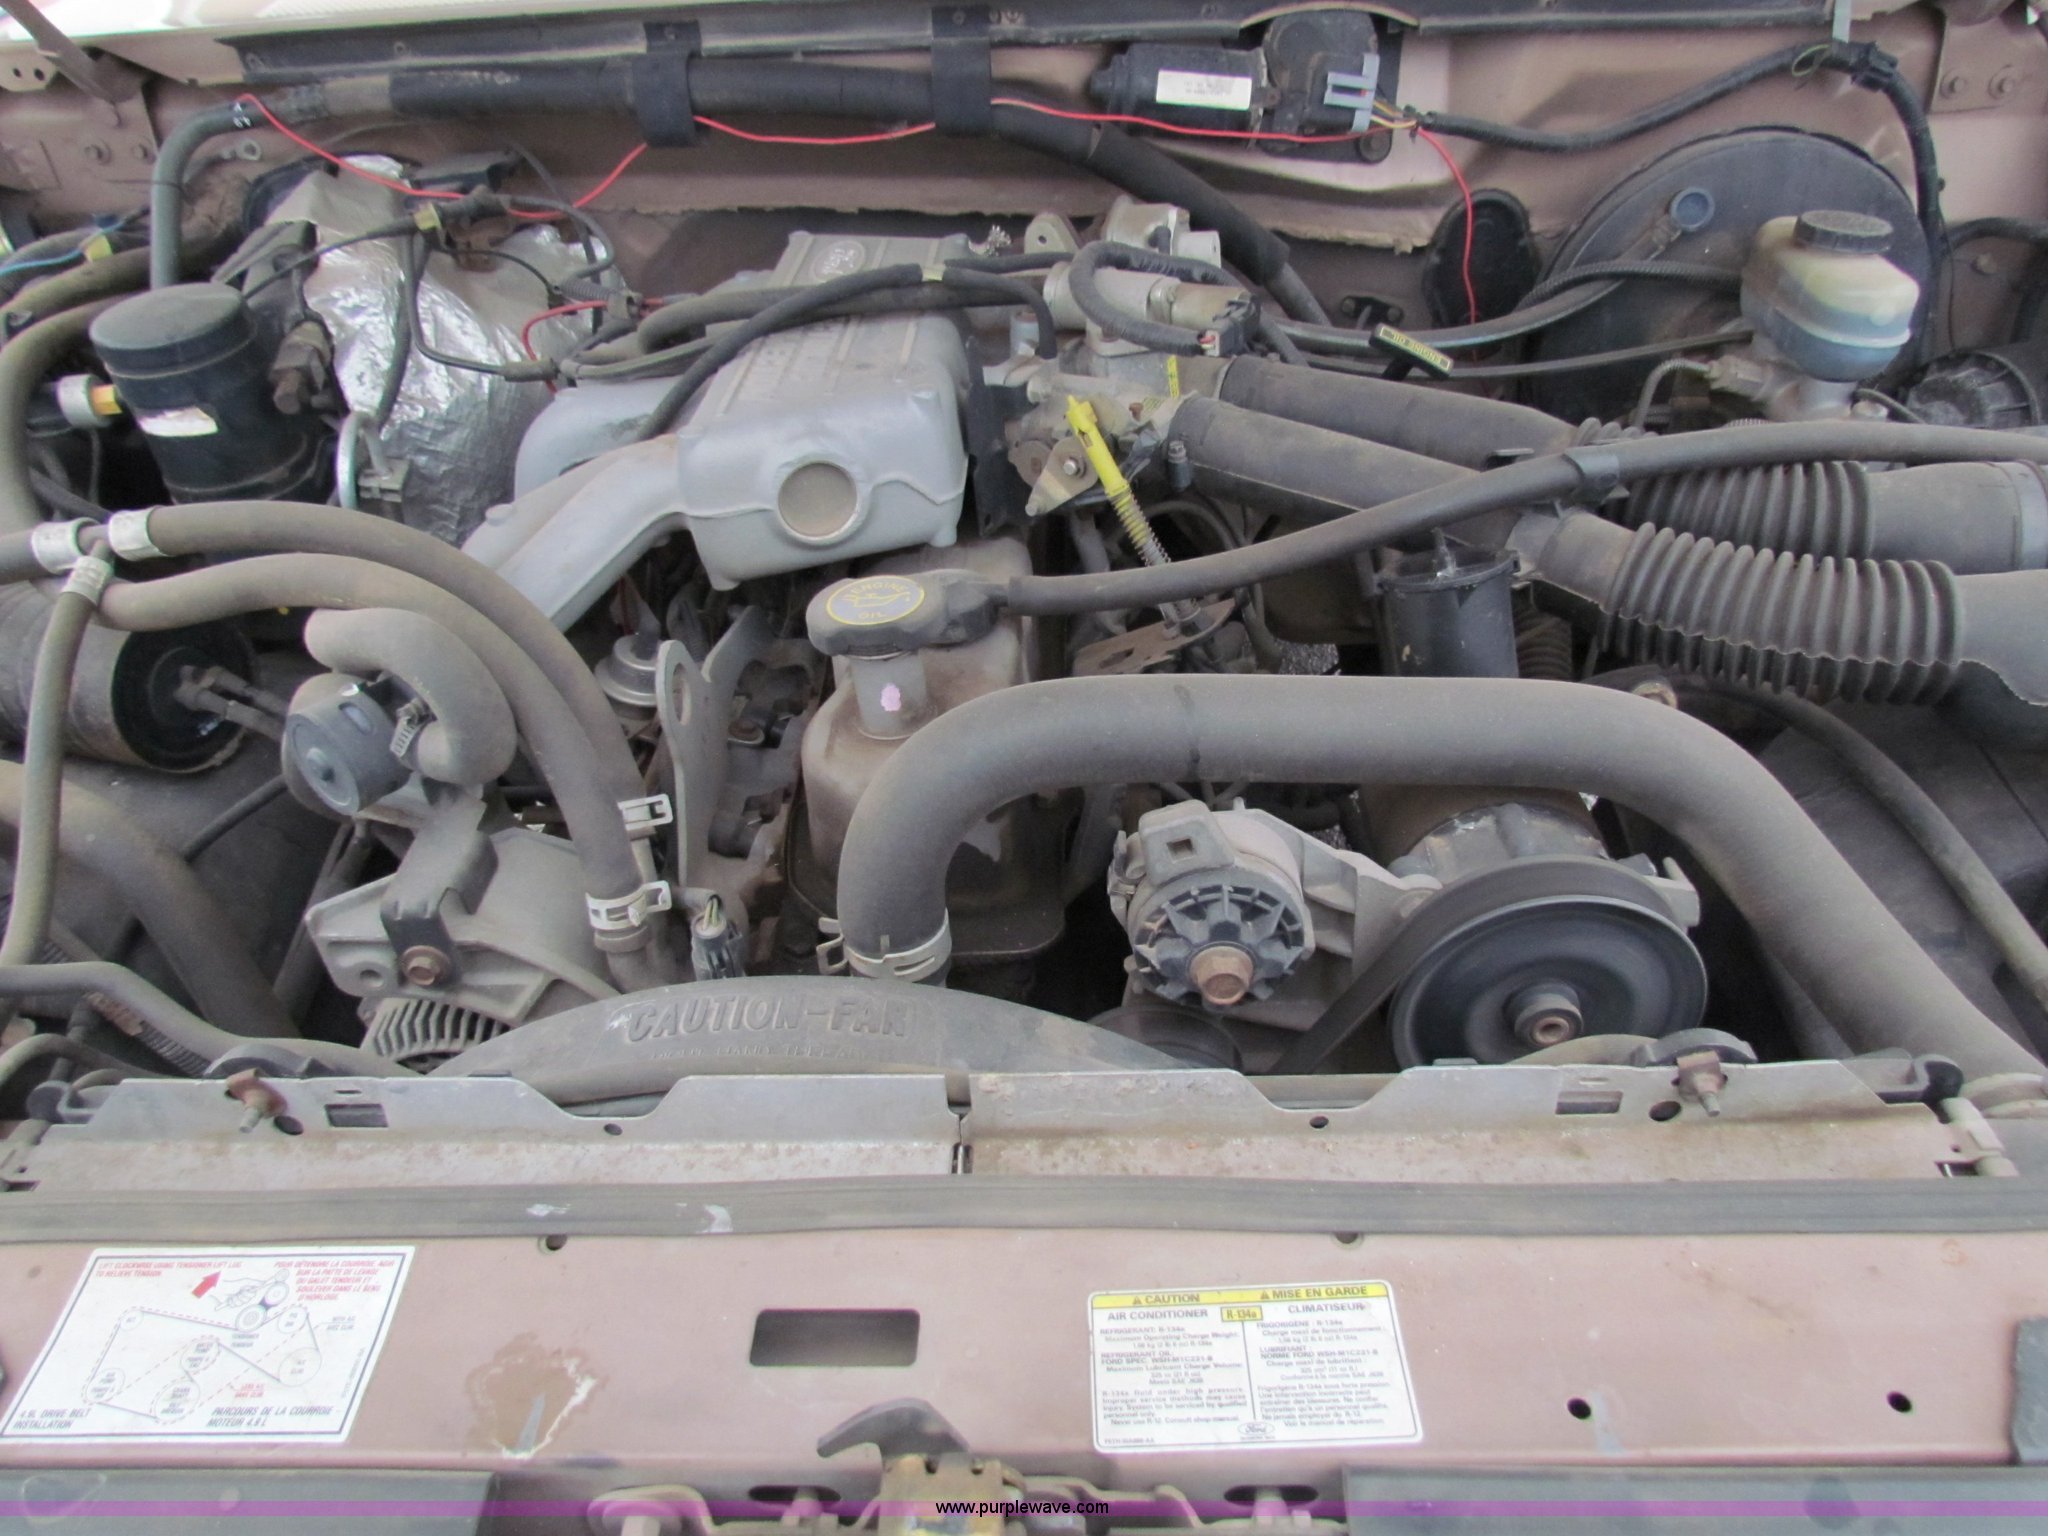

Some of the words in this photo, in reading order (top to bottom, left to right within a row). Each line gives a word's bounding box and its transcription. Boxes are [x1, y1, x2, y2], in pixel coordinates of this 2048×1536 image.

[850, 582, 909, 594] ENGINE
[1272, 1289, 1304, 1298] MISE
[1306, 1288, 1321, 1297] EN
[1325, 1286, 1367, 1296] GARDE
[1145, 1294, 1200, 1304] CAUTION
[1288, 1302, 1364, 1314] CLIMATISEUR
[1108, 1311, 1126, 1320] AIR
[1130, 1309, 1208, 1320] CONDITIONER
[1226, 1308, 1257, 1319] R-134a
[1100, 1326, 1156, 1335] REFRIGERANT:
[1186, 1388, 1203, 1396] high
[41, 1408, 68, 1418] DRIVE
[69, 1408, 91, 1417] BELT
[211, 1406, 259, 1416] PARCOURS
[260, 1406, 272, 1416] DE
[274, 1406, 287, 1416] LA
[289, 1406, 333, 1415] COURROIE
[12, 1420, 74, 1429] INSTALLATION
[206, 1417, 245, 1427] MOTEUR
[1245, 1423, 1267, 1433] Ford
